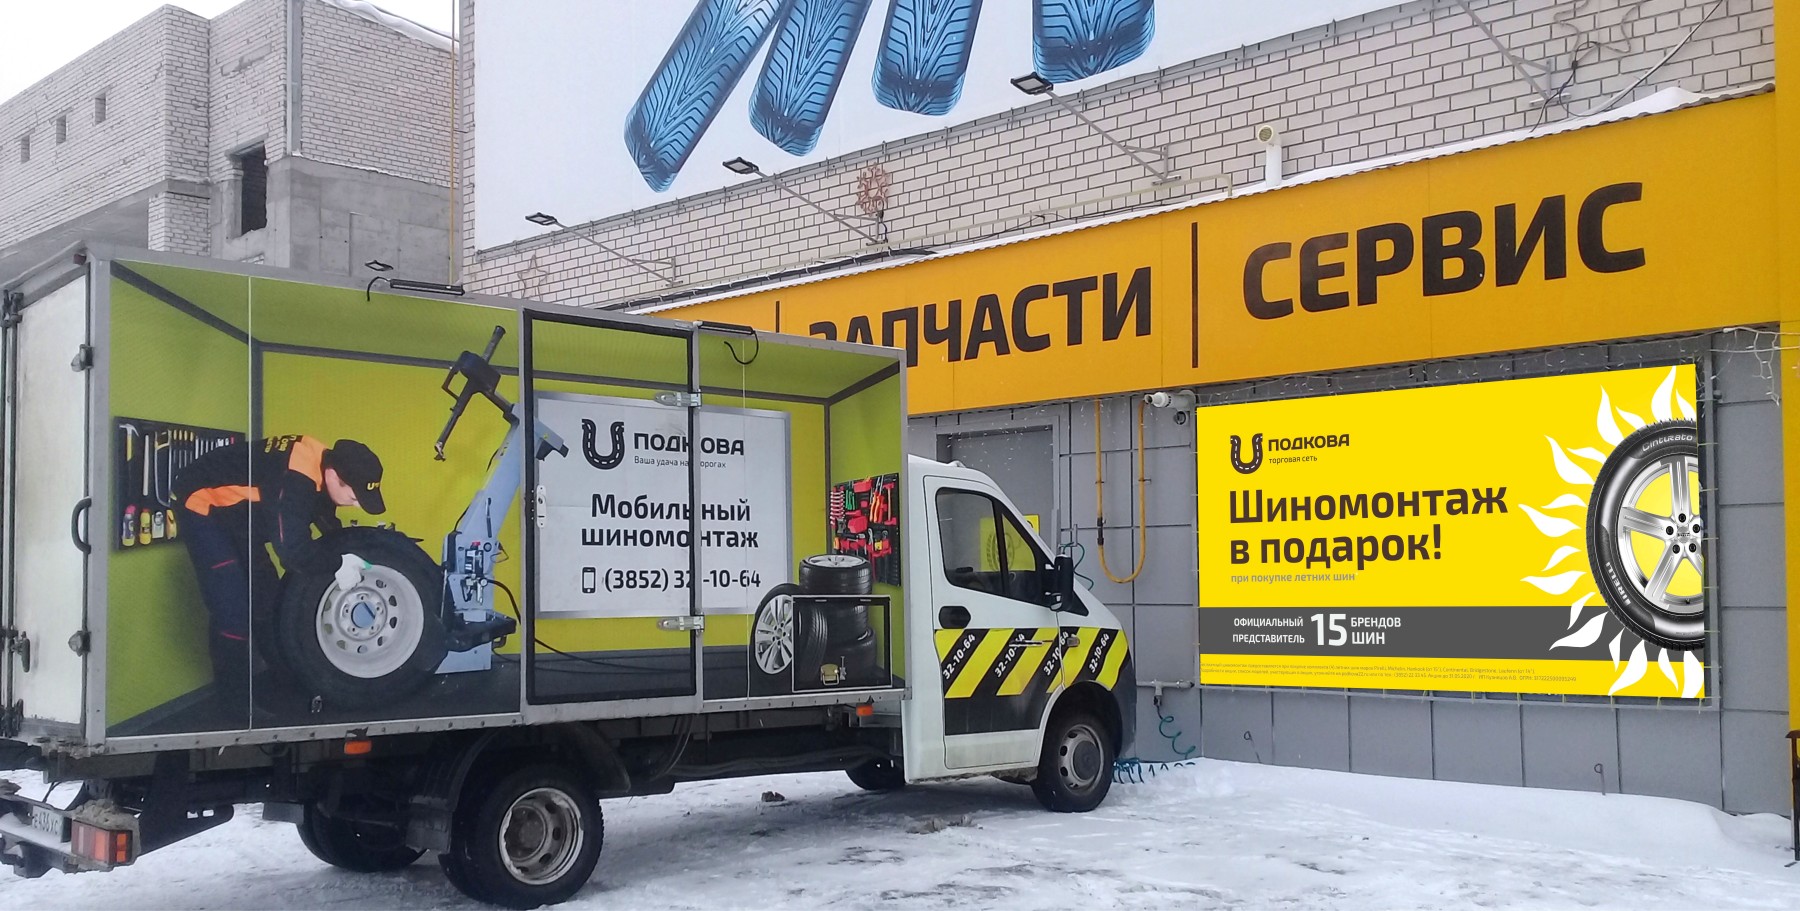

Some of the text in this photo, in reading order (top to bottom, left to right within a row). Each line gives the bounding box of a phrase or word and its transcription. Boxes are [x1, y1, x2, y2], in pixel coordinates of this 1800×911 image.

[1243, 182, 1646, 320] СЕРВИС
[809, 266, 1152, 368] ПЧАСТИ
[1268, 434, 1350, 452] ПОДКОВА
[634, 455, 655, 465] Ваша
[656, 459, 679, 467] удача
[1268, 456, 1301, 465] торговая
[1229, 486, 1508, 524] Шиномонтаж
[581, 528, 759, 548] шиномонтаж
[1230, 523, 1442, 571] в подарок!
[604, 567, 669, 593] (3852)
[1231, 575, 1249, 585] при
[1251, 573, 1292, 585] покупке
[1294, 573, 1330, 582] летних
[1234, 616, 1304, 627] ОФИЦИАЛЬНЫЙ
[1310, 613, 1348, 646] 15
[1351, 617, 1402, 629] БРЕНДОВ
[1232, 634, 1305, 644] ПРЕДСТАВИТЕЛЬ
[1351, 632, 1386, 645] ШИН
[942, 633, 976, 680] 32-10-64
[994, 633, 1025, 678] 32-10-4
[1088, 634, 1110, 673] 32-10-64
